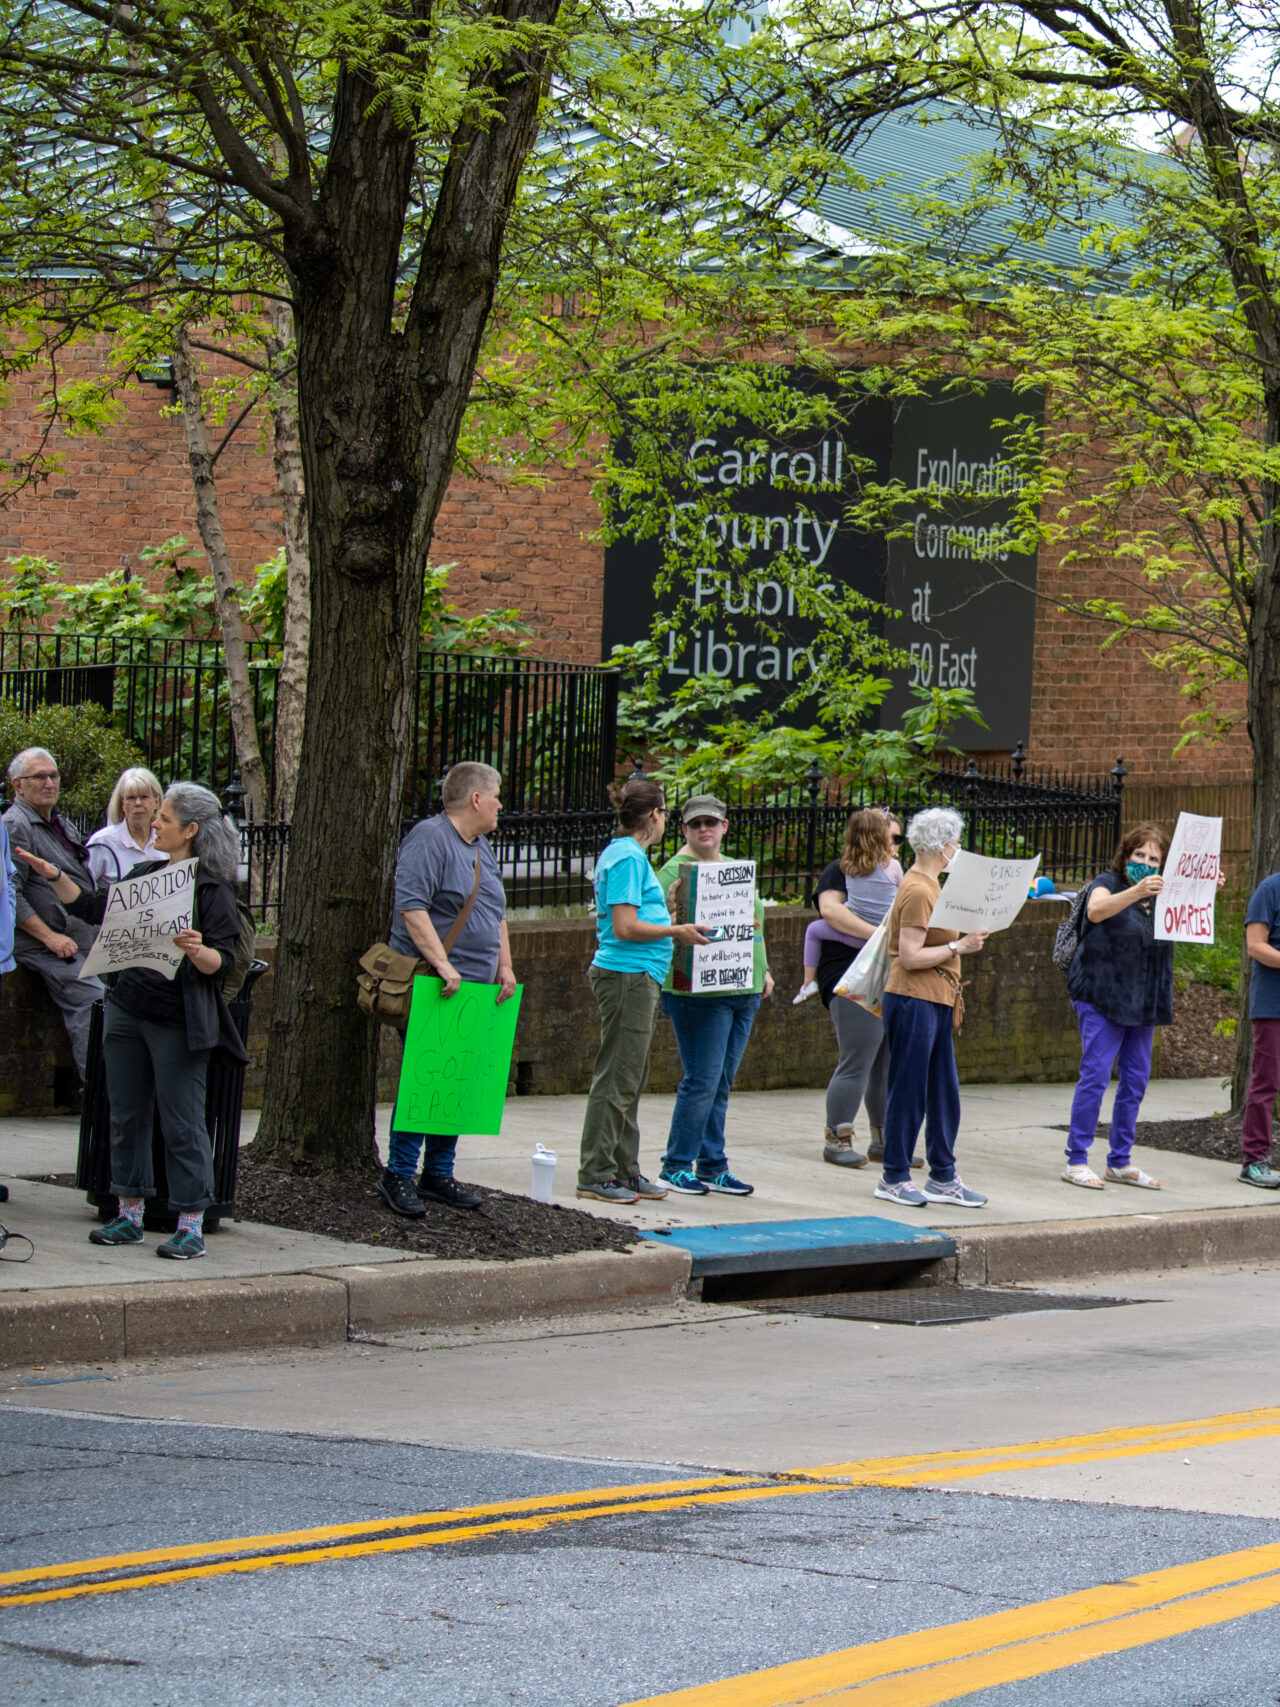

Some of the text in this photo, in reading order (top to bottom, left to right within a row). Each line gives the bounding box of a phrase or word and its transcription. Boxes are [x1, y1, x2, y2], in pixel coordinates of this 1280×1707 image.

[687, 438, 843, 486] Carroll
[669, 502, 839, 566] County
[694, 567, 836, 618] Publc
[911, 582, 932, 623] at
[667, 629, 830, 696] Library
[908, 642, 978, 688] 50 East
[718, 865, 754, 884] DECISION
[990, 865, 1021, 879] GIRLS
[1174, 853, 1220, 880] ROSARIES
[108, 862, 198, 912] ABORTION
[99, 911, 191, 943] HEALTHCARE
[136, 908, 154, 925] IS
[1164, 902, 1212, 936] OVARIES
[107, 952, 180, 967] ACCESSIBLE
[108, 946, 152, 960] SAFE
[700, 969, 717, 984] HER
